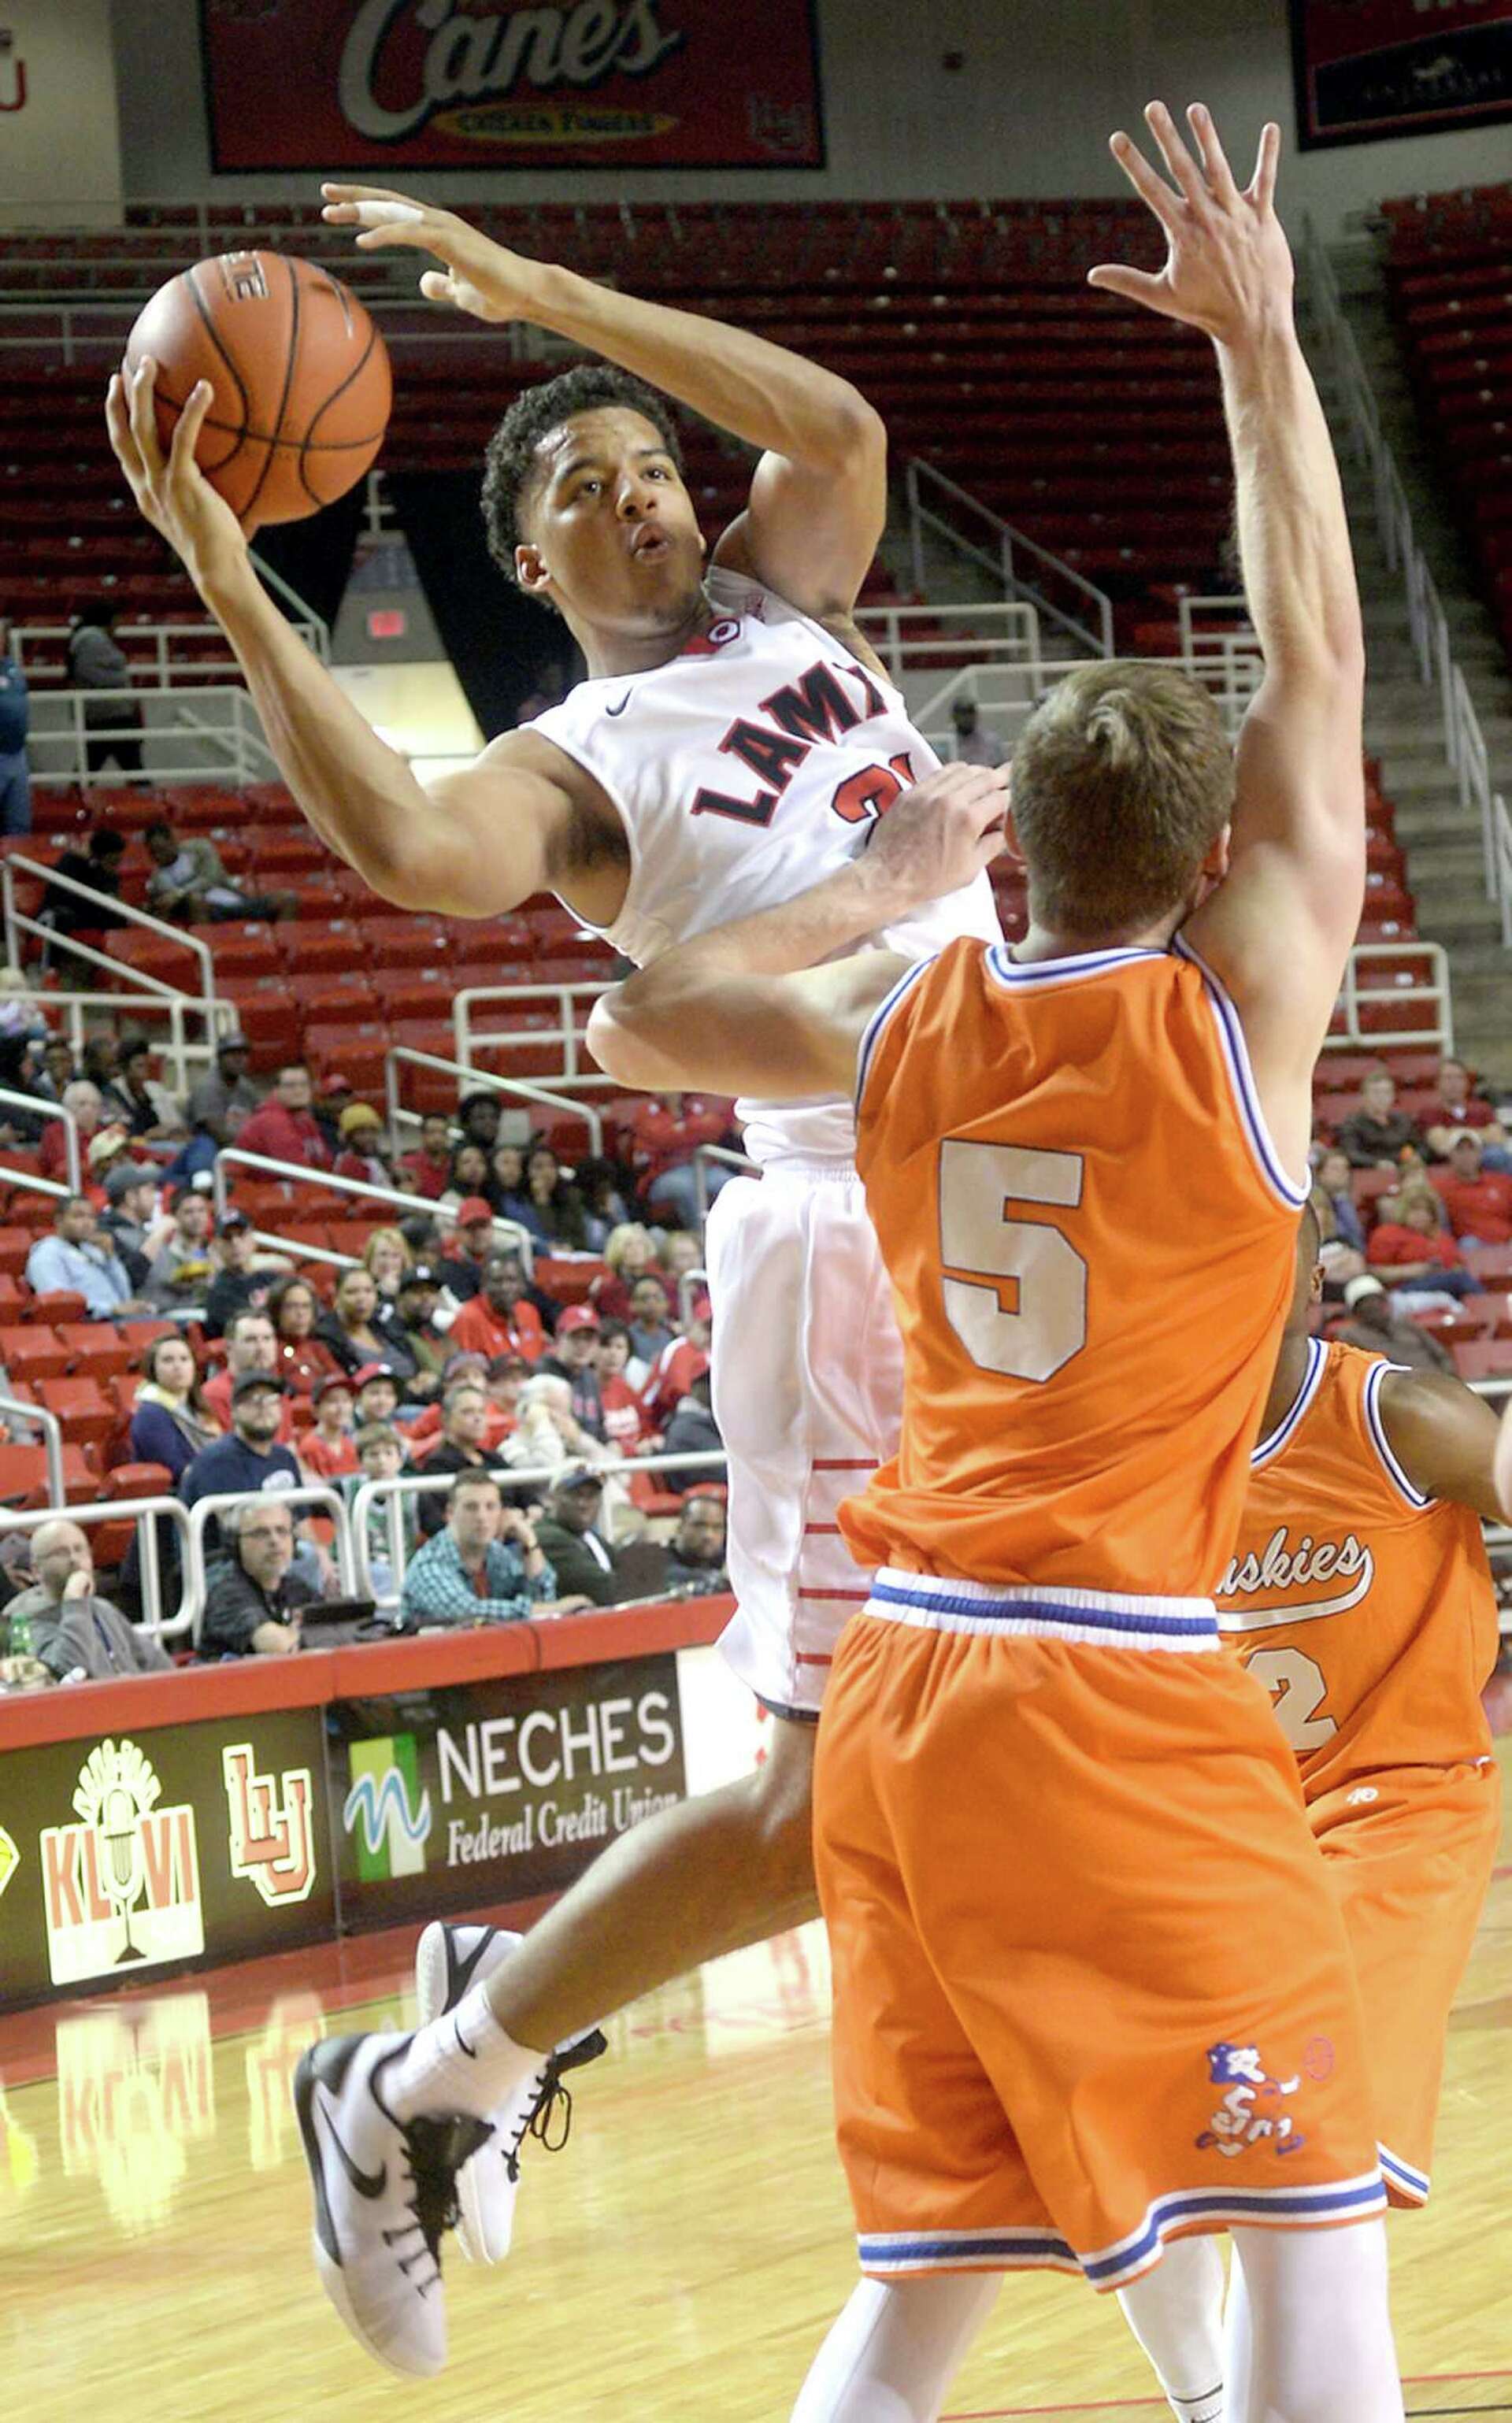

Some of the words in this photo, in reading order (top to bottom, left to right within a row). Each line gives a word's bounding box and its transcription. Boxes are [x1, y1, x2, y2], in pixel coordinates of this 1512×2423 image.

[939, 1138, 1088, 1384] 5
[1215, 1525, 1373, 1596] uskies
[436, 1691, 676, 1803] NECHES
[1247, 1647, 1339, 1751] 2
[447, 1804, 534, 1867] Federal
[538, 1792, 608, 1847] Credit
